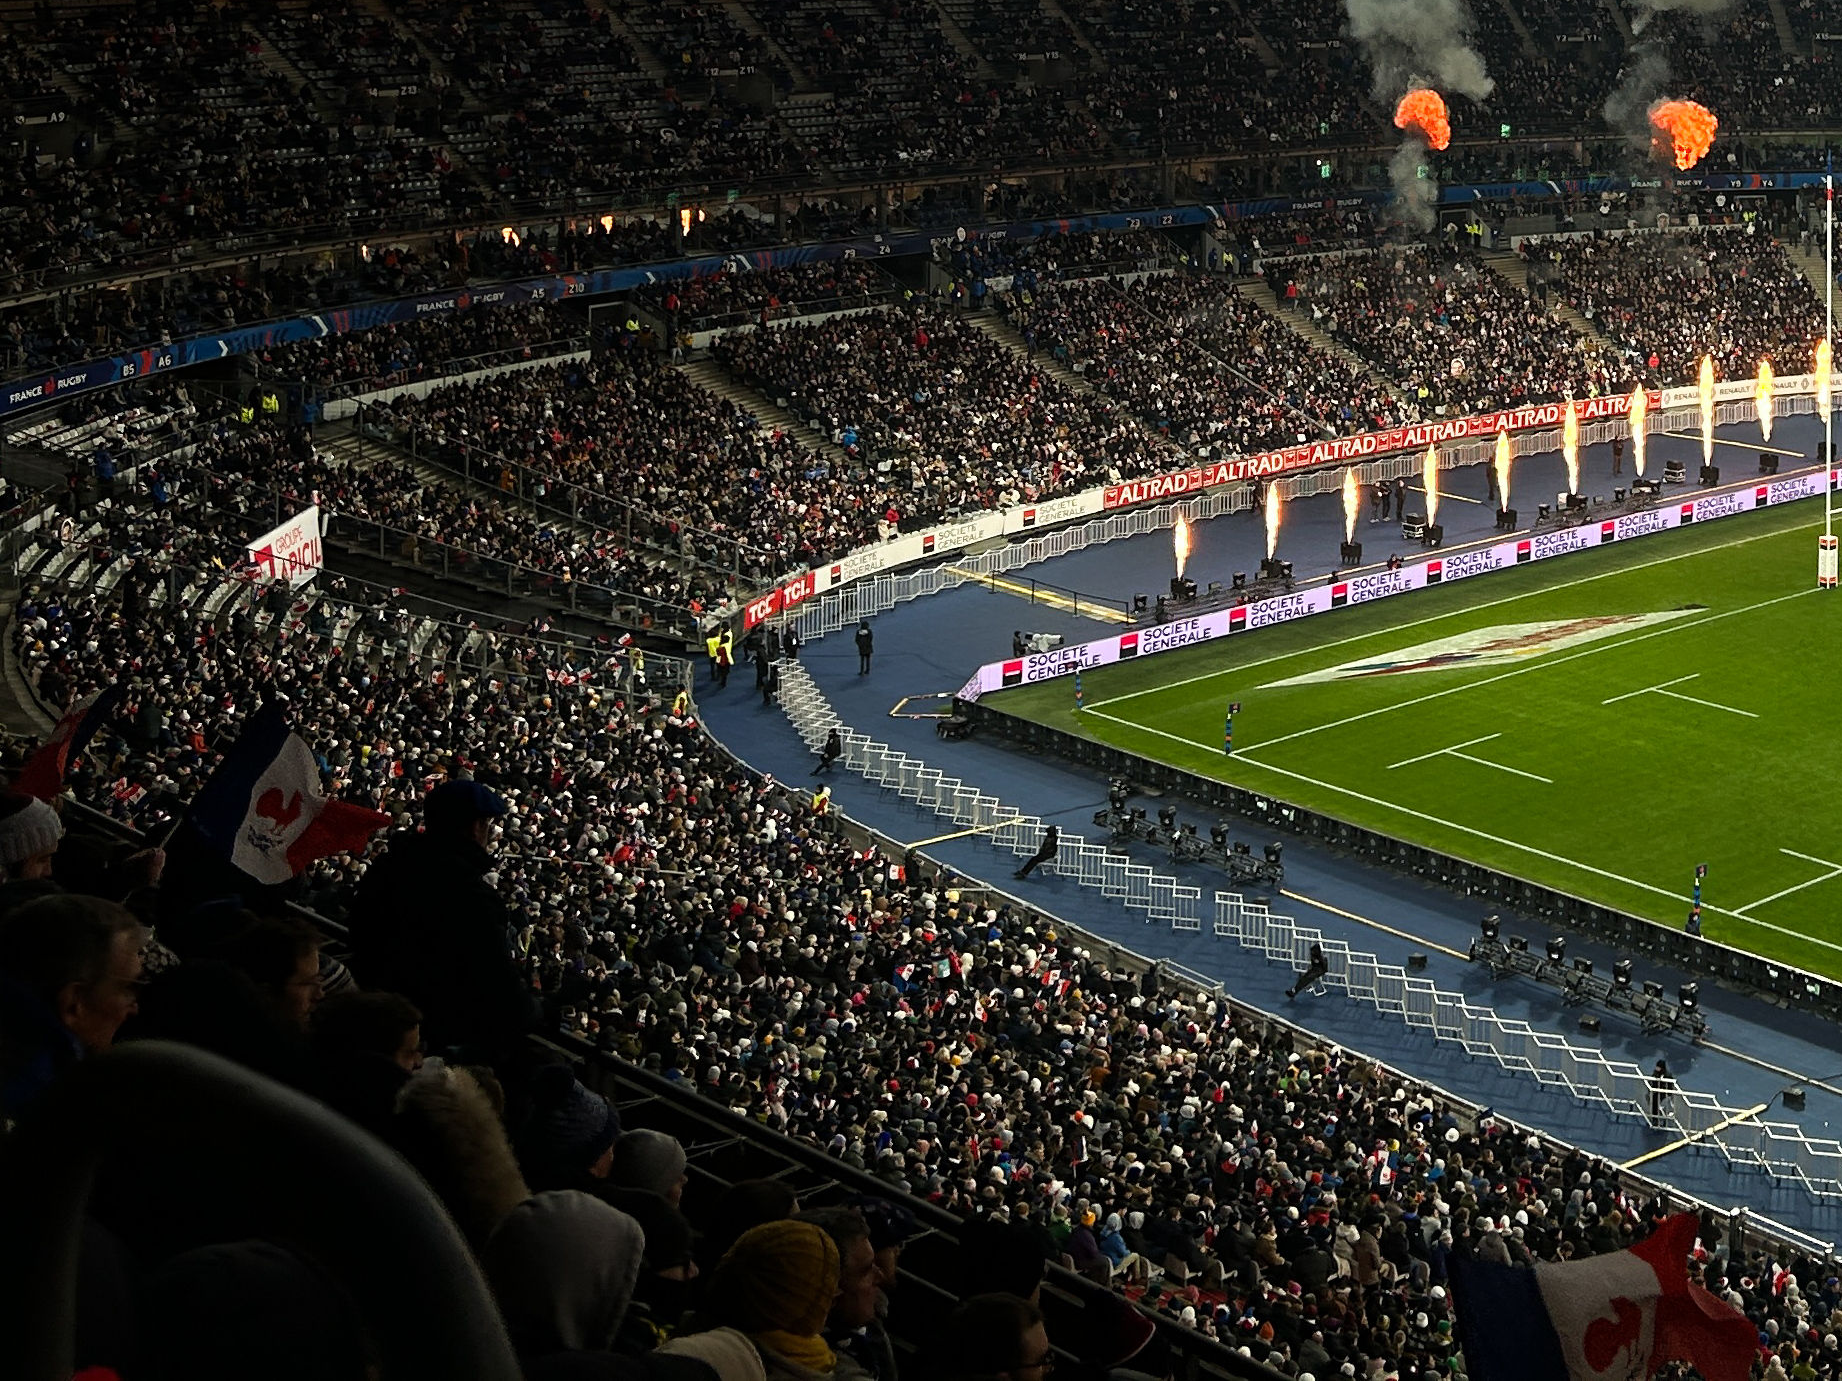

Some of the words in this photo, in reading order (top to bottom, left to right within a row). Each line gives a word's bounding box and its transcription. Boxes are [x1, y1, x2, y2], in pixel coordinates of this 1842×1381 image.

[416, 299, 455, 313] FRANCE
[9, 385, 43, 405] FRANCE
[57, 373, 87, 390] RUGBY
[1495, 405, 1559, 431] ALTRAD
[1403, 420, 1468, 448] ALTRAD
[1310, 435, 1377, 463] ALTRAD
[1215, 454, 1283, 483] ALTRAD
[1118, 474, 1188, 505] ALTRAD
[1770, 486, 1816, 504] GENERALE
[1771, 477, 1808, 494] SOCIETE
[1697, 494, 1736, 510] SOCIETE
[1697, 502, 1744, 521] GENERALE
[1618, 511, 1660, 529] SOCIETE
[1618, 519, 1668, 539] GENERALE
[1535, 530, 1578, 548] SOCIETE
[1535, 538, 1587, 558] GENERALE
[1446, 549, 1493, 569] SOCIETE
[1446, 558, 1502, 579] GENERALE
[1351, 579, 1412, 603] GENERALE
[1352, 571, 1401, 590] SOCIETE
[1251, 595, 1304, 616] SOCIETE
[1251, 603, 1315, 627] GENERALE
[1143, 628, 1212, 653] GENERALE
[1144, 619, 1200, 641] SOCIETE
[1028, 645, 1088, 669] SOCIETE
